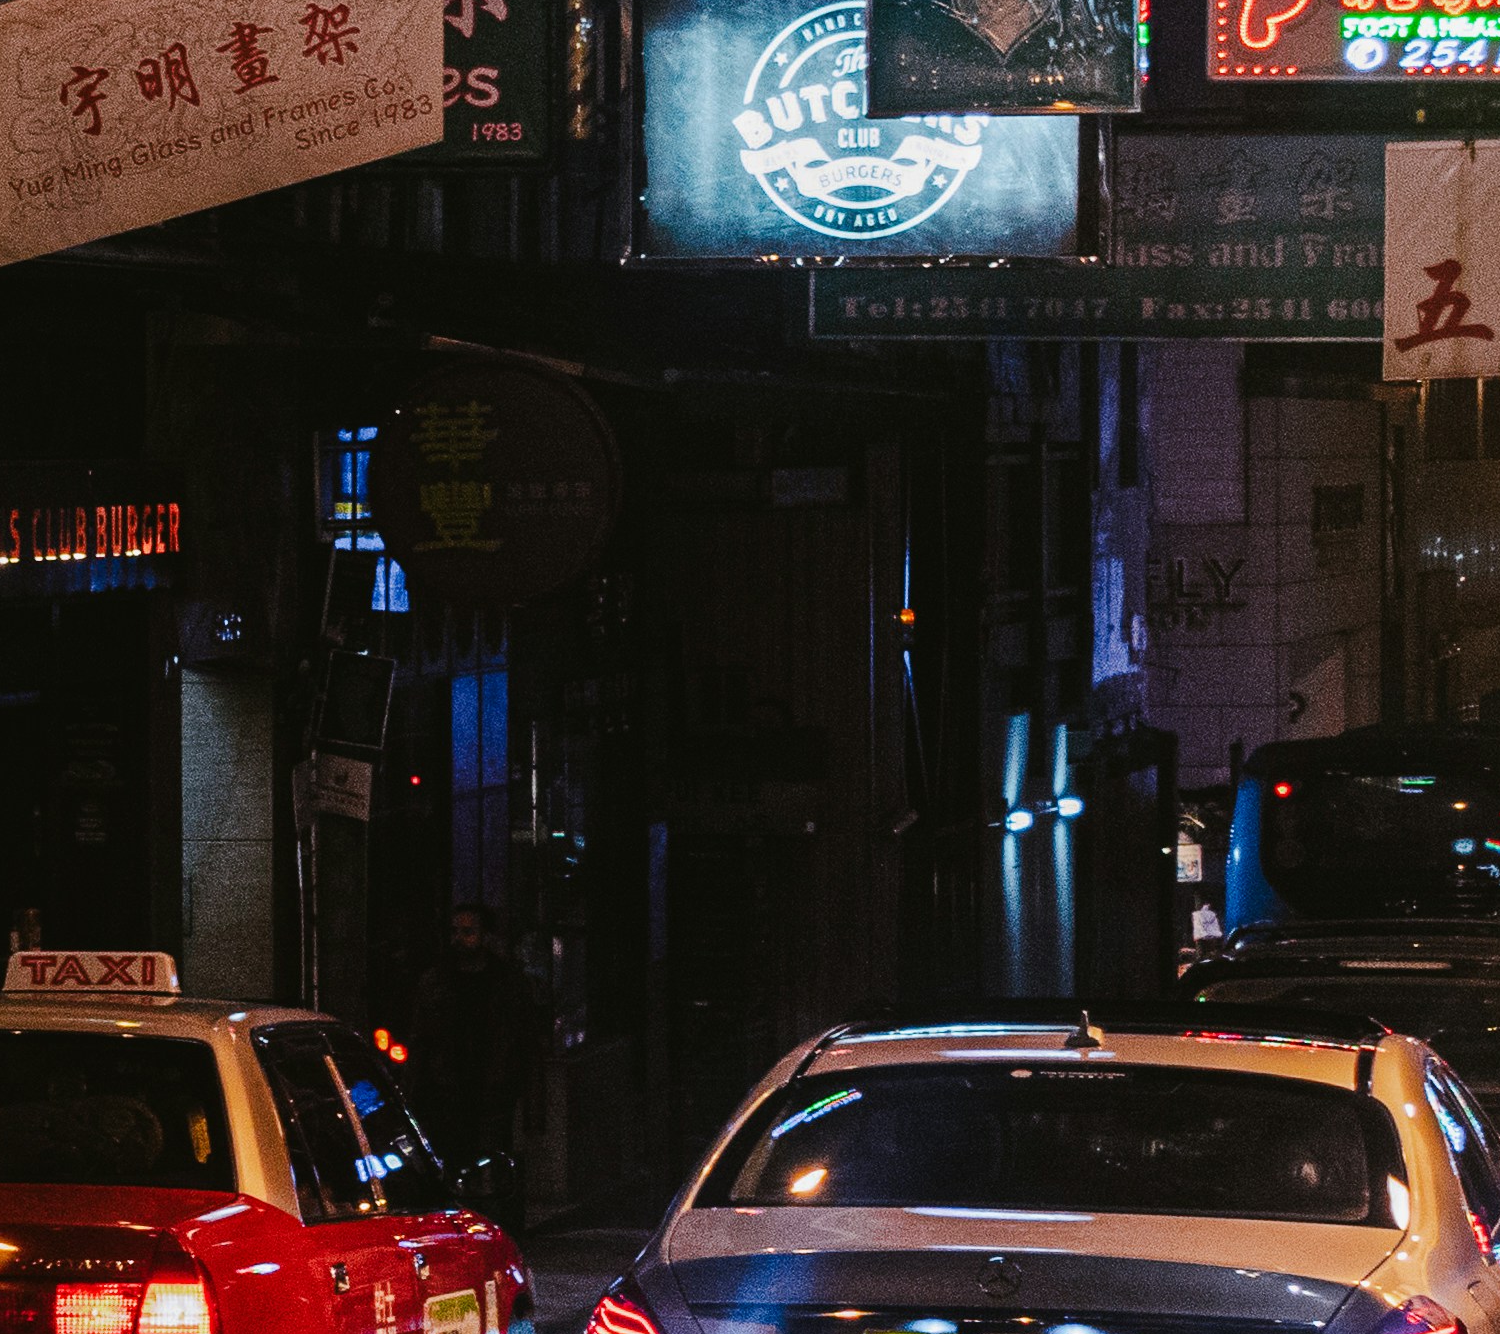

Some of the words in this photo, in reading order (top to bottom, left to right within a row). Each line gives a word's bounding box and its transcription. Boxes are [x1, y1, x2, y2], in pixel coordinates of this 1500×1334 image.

[58, 2, 362, 138] 宇明畫架
[9, 173, 55, 202] Yue
[61, 155, 124, 189] Ming
[132, 138, 202, 171] Glass
[211, 116, 254, 145] and
[263, 86, 357, 131] Frames
[363, 75, 406, 103] Co.
[293, 118, 361, 152] Since
[371, 94, 434, 129] 1983
[471, 122, 524, 142] 1983
[838, 127, 881, 149] CLUB
[817, 164, 904, 190] BURGERS
[813, 204, 850, 226] DRY
[853, 206, 898, 228] AGED
[1209, 235, 1287, 269] and
[31, 506, 88, 562] CLUB
[95, 502, 181, 557] BURGER
[22, 955, 156, 986] TAXI
